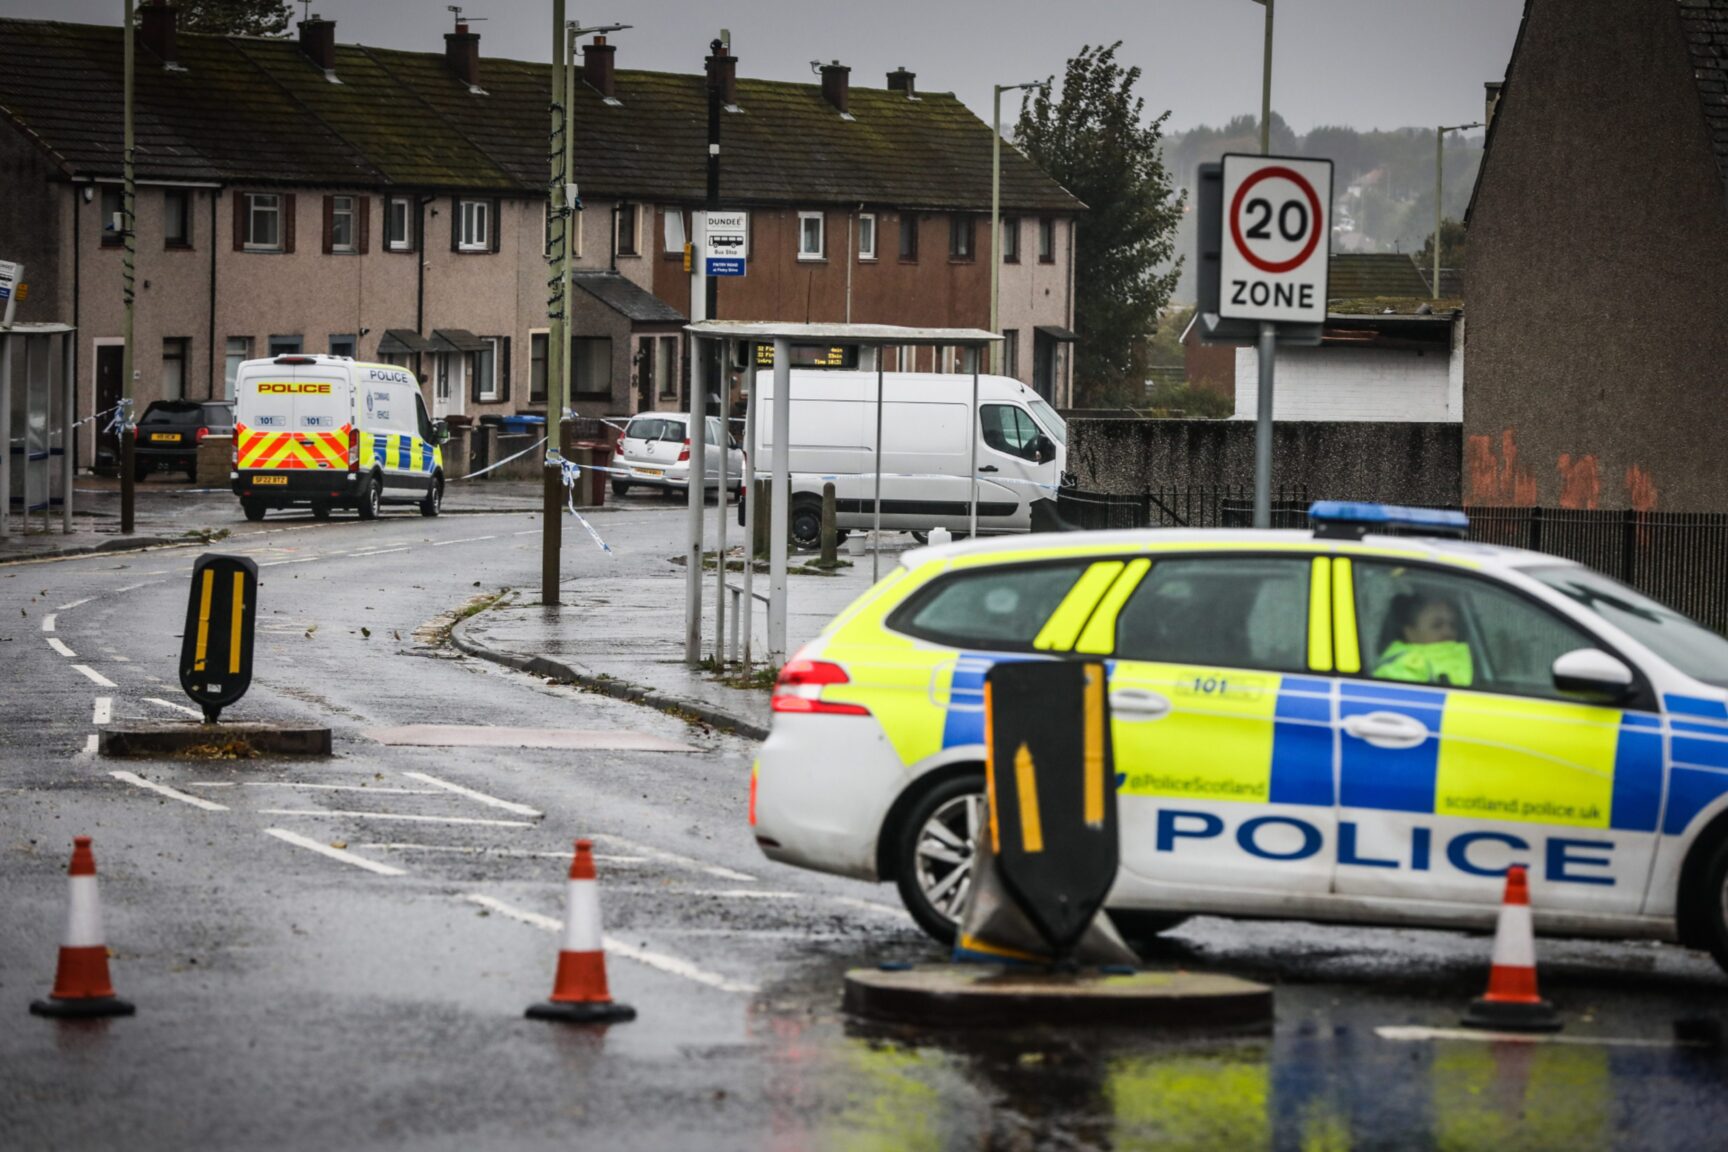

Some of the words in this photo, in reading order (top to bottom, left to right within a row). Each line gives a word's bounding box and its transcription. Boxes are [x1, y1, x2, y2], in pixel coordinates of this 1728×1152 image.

[1245, 197, 1308, 242] 20
[1231, 280, 1314, 309] ZONE
[370, 370, 408, 383] POLICE
[258, 384, 331, 393] POLICE
[260, 417, 273, 425] 101
[307, 417, 320, 425] 101
[1194, 678, 1227, 694] 101
[1130, 774, 1266, 797] @PoliceScotland
[1446, 795, 1601, 819] scotland.police.uk
[1156, 809, 1616, 886] POLICE
